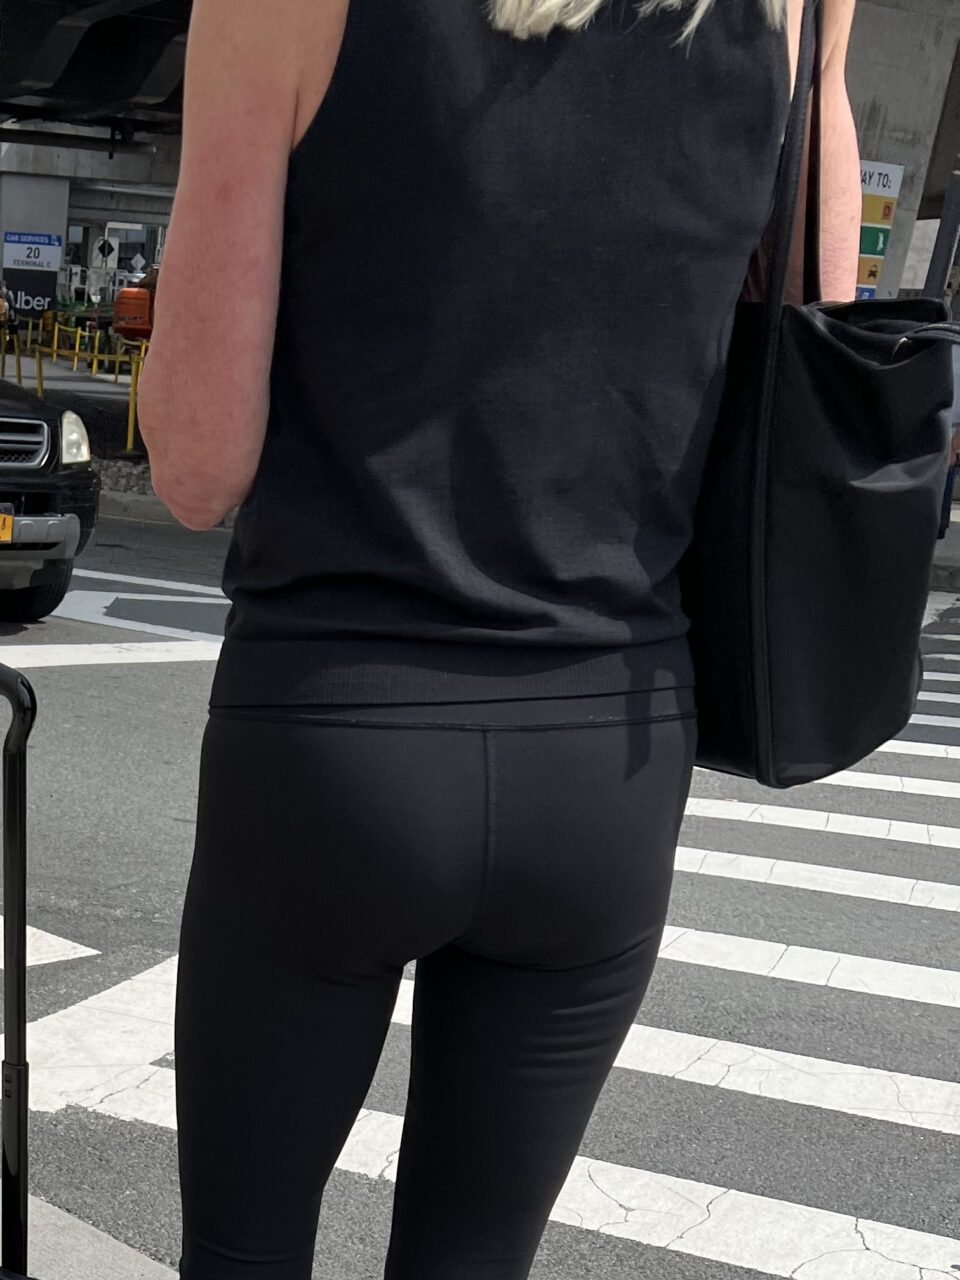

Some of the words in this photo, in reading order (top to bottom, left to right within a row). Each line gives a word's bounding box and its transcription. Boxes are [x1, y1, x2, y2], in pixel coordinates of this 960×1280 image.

[860, 169, 874, 186] AY
[877, 172, 892, 189] TO:
[26, 247, 40, 259] 20
